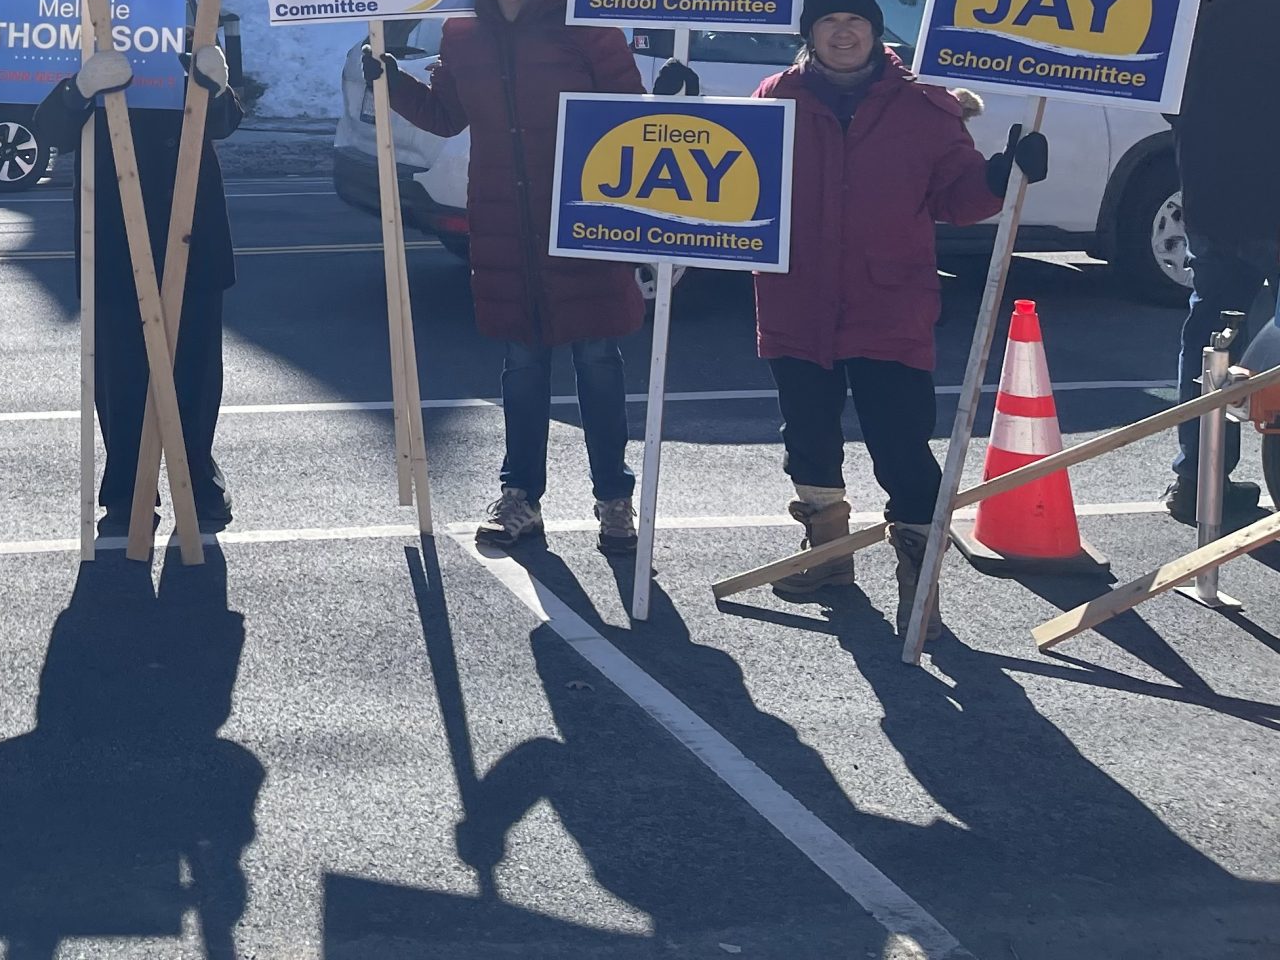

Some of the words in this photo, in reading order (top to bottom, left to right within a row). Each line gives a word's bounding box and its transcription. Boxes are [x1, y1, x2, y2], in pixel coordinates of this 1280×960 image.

[275, 0, 379, 17] Committee
[937, 48, 1012, 72] School
[1018, 54, 1147, 88] Committee
[642, 123, 710, 144] Eileen
[597, 145, 743, 203] JAY
[572, 222, 641, 242] School
[647, 227, 764, 251] Committee
